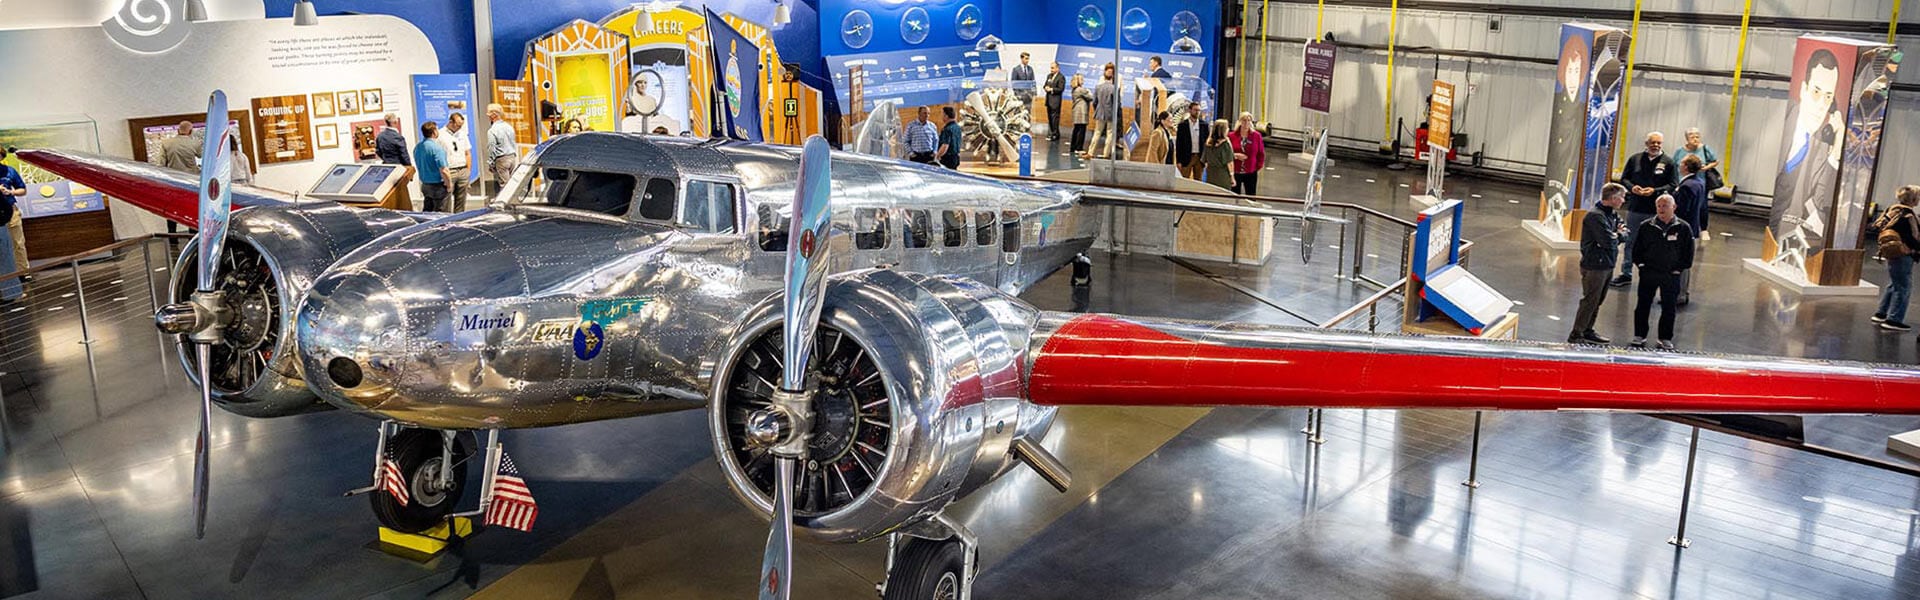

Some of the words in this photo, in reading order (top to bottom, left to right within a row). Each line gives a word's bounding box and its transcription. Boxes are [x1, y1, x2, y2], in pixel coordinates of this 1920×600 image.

[632, 19, 685, 39] CEERS
[258, 105, 294, 117] GROWING
[294, 104, 305, 114] UP
[459, 310, 517, 331] Muriel
